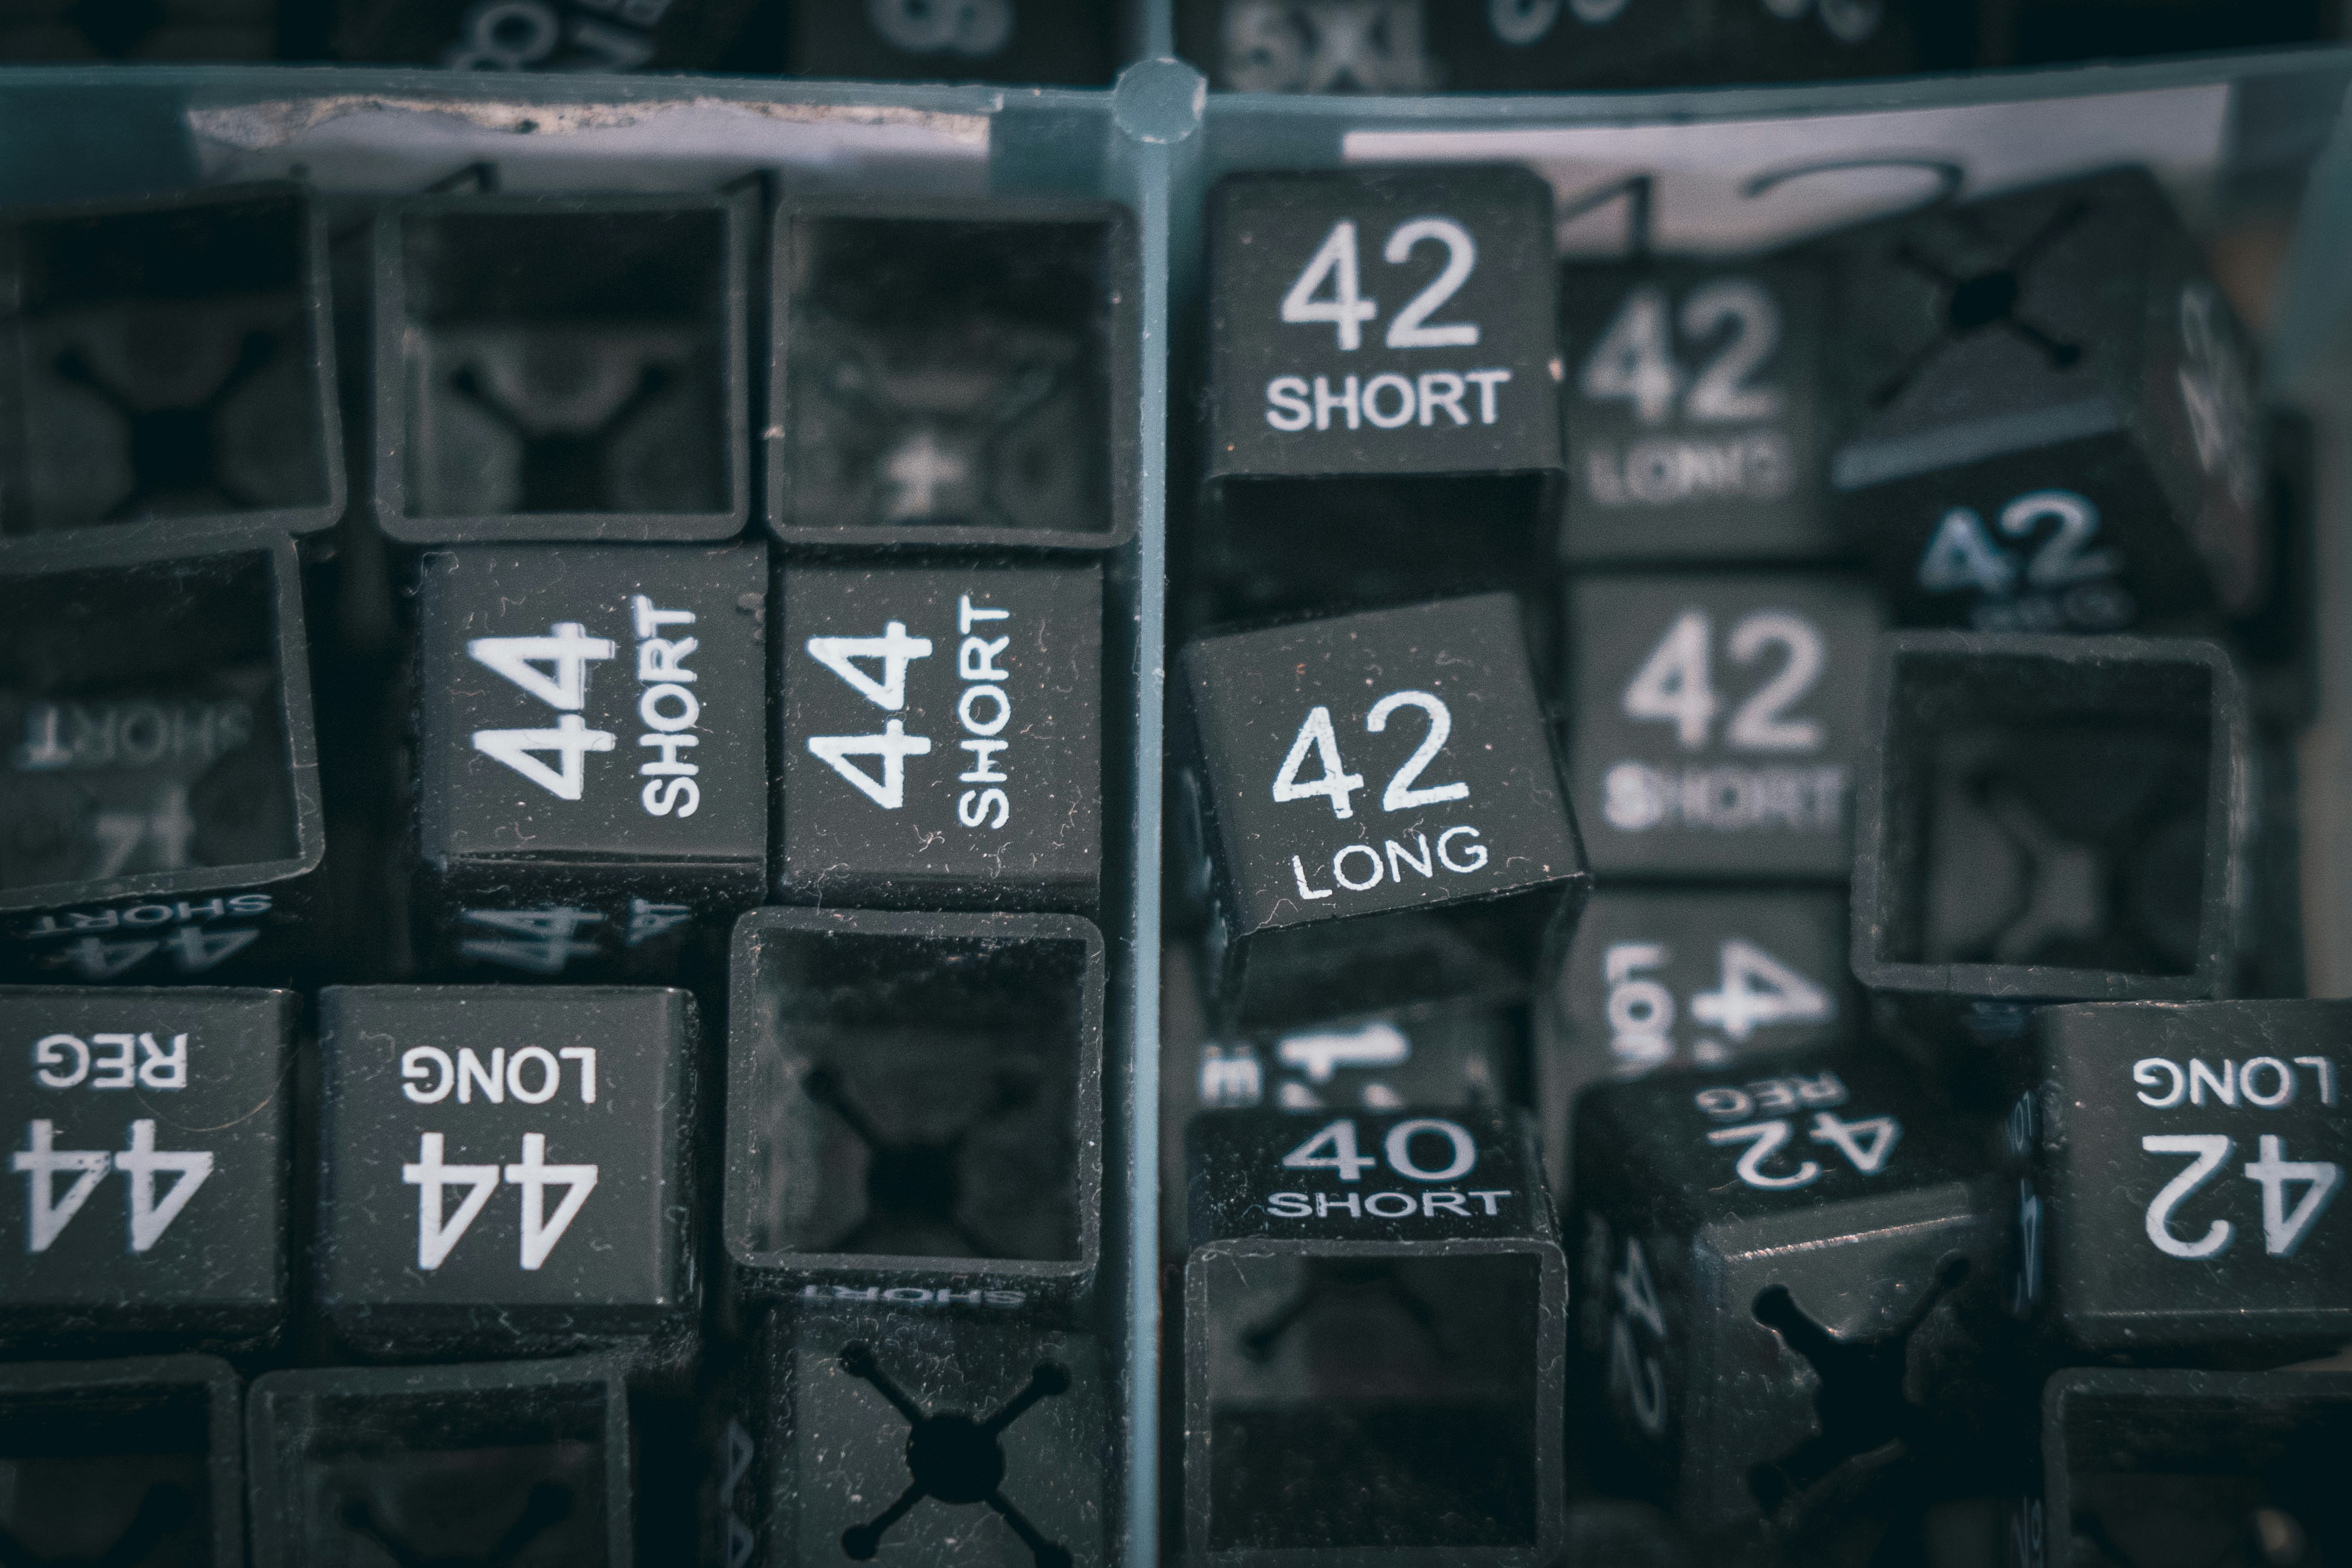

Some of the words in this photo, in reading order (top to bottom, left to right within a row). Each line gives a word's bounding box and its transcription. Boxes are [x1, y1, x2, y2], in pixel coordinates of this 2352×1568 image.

[1281, 217, 1480, 351] 42
[1265, 368, 1512, 432] SHORT
[1581, 282, 1783, 424] 42
[1918, 489, 2125, 596] 42
[467, 621, 616, 800] 44
[632, 595, 700, 818] SHORT
[806, 621, 932, 809] 44
[957, 595, 1011, 829] SHORT
[1622, 610, 1826, 750] 42
[1272, 690, 1470, 819] 42
[27, 893, 272, 939] SHORT
[1293, 825, 1488, 899] LONG
[57, 926, 261, 980] 44
[1691, 938, 1838, 1067] 4
[36, 1033, 187, 1089] REG
[400, 1046, 596, 1104] LONG
[1695, 1069, 1849, 1121] REG
[2133, 1056, 2337, 1107] LONG
[13, 1119, 213, 1252] 44
[402, 1132, 597, 1270] 44
[1267, 1190, 1512, 1219] SHORT
[1283, 1118, 1477, 1182] 40
[1707, 1111, 1903, 1189] 42
[2142, 1134, 2343, 1260] 42
